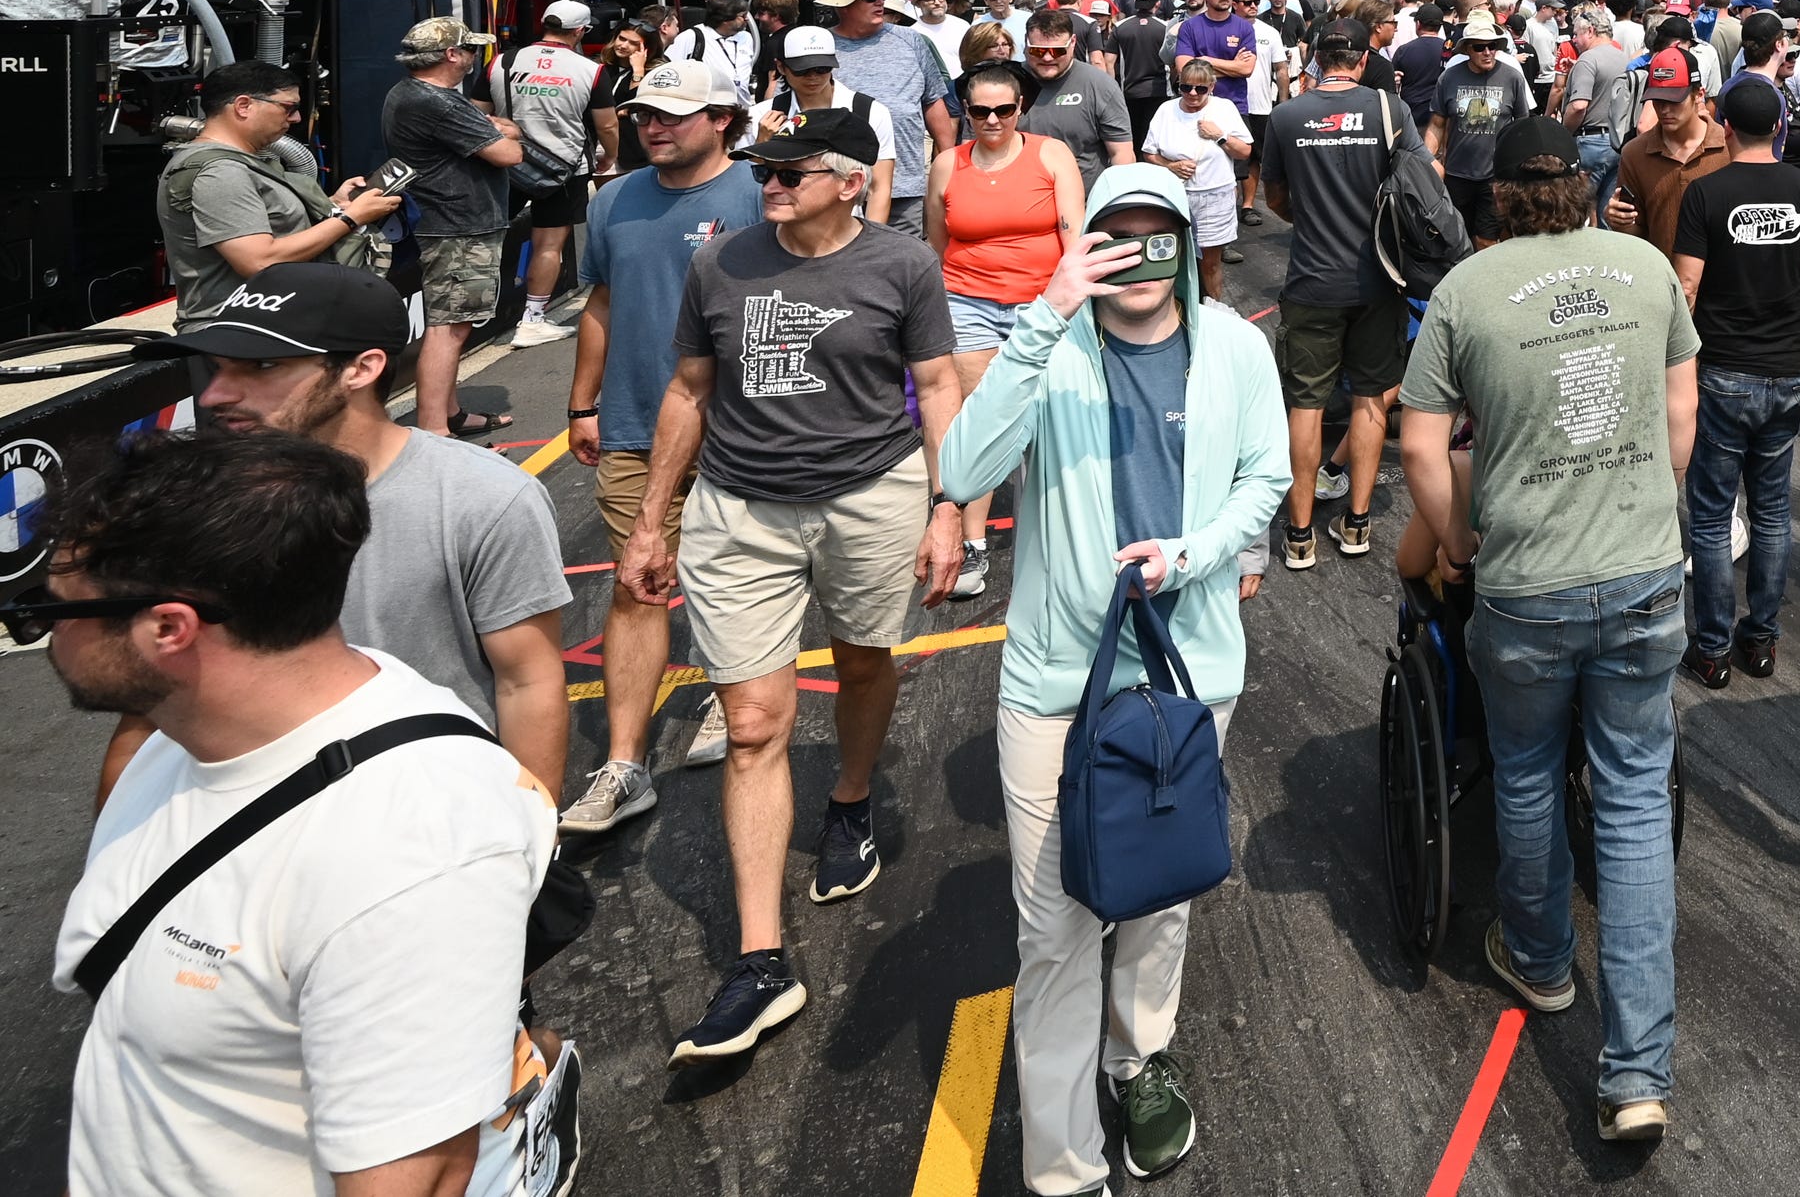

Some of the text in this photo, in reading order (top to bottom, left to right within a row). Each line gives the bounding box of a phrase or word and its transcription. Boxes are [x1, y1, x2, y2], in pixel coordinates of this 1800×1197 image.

[1, 57, 48, 73] RLL
[535, 58, 553, 69] 13
[527, 74, 574, 87] IMSA
[514, 85, 560, 98] VIDEO
[1342, 112, 1364, 131] 81
[1756, 219, 1795, 239] MILE
[1508, 265, 1634, 305] WHISKEY JAM
[1553, 287, 1600, 309] LUKE
[778, 306, 810, 318] run
[1548, 298, 1612, 327] COMBS
[775, 333, 810, 341] Triathlete
[1519, 321, 1640, 350] BOOTLEGGERS TAILGATE
[745, 329, 760, 395] #RaceLocal
[766, 359, 777, 379] Bike
[1551, 362, 1593, 376] UNIVERSITY
[759, 382, 793, 394] SWIM
[1560, 387, 1582, 397] SANTA
[1558, 403, 1574, 411] SALT
[1577, 399, 1594, 408] LAKE
[1554, 418, 1571, 426] EAST
[1540, 441, 1636, 469] GROWIN' UP AND
[1520, 451, 1654, 486] GETTIN' OLD TOUR 2024
[163, 925, 226, 960] McLaren
